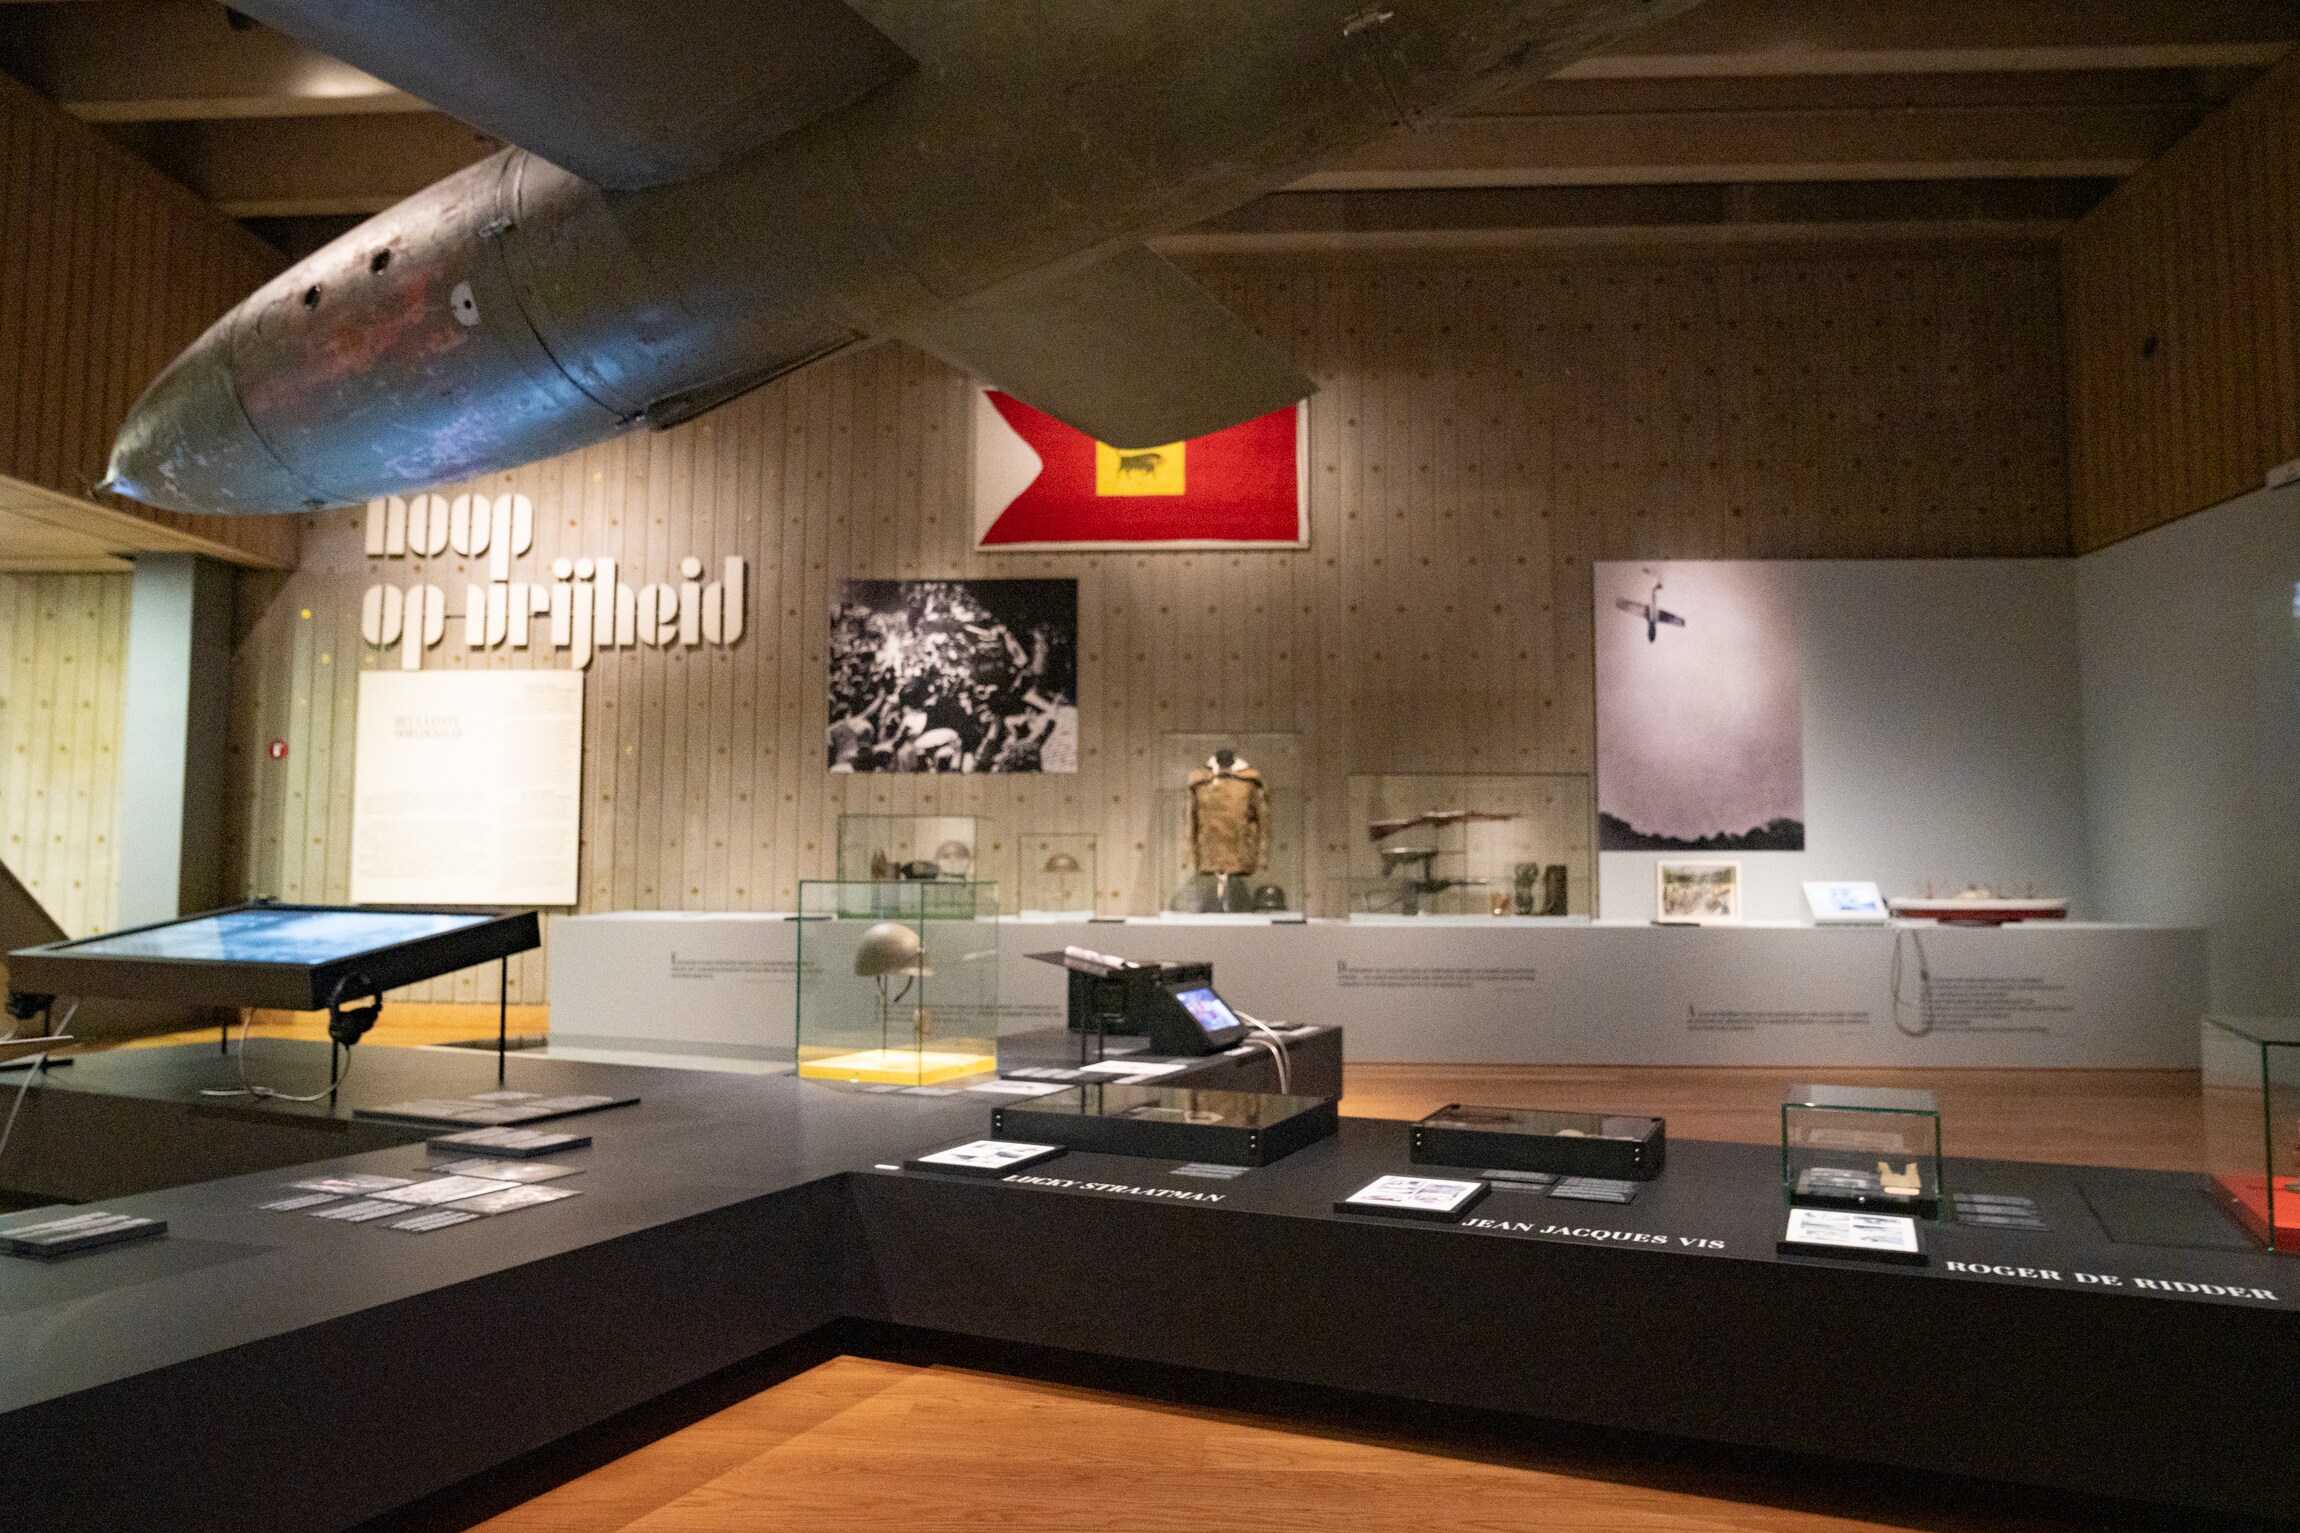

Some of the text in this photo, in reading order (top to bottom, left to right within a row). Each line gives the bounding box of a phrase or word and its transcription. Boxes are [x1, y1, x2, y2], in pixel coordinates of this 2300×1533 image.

[362, 556, 744, 671] op vrijheid
[1001, 1174, 1226, 1202] LUCKY STRAATMAN
[1461, 1218, 1726, 1249] JEAN JACQUES VIS
[1946, 1261, 2280, 1300] ROGER DE RIDDER
